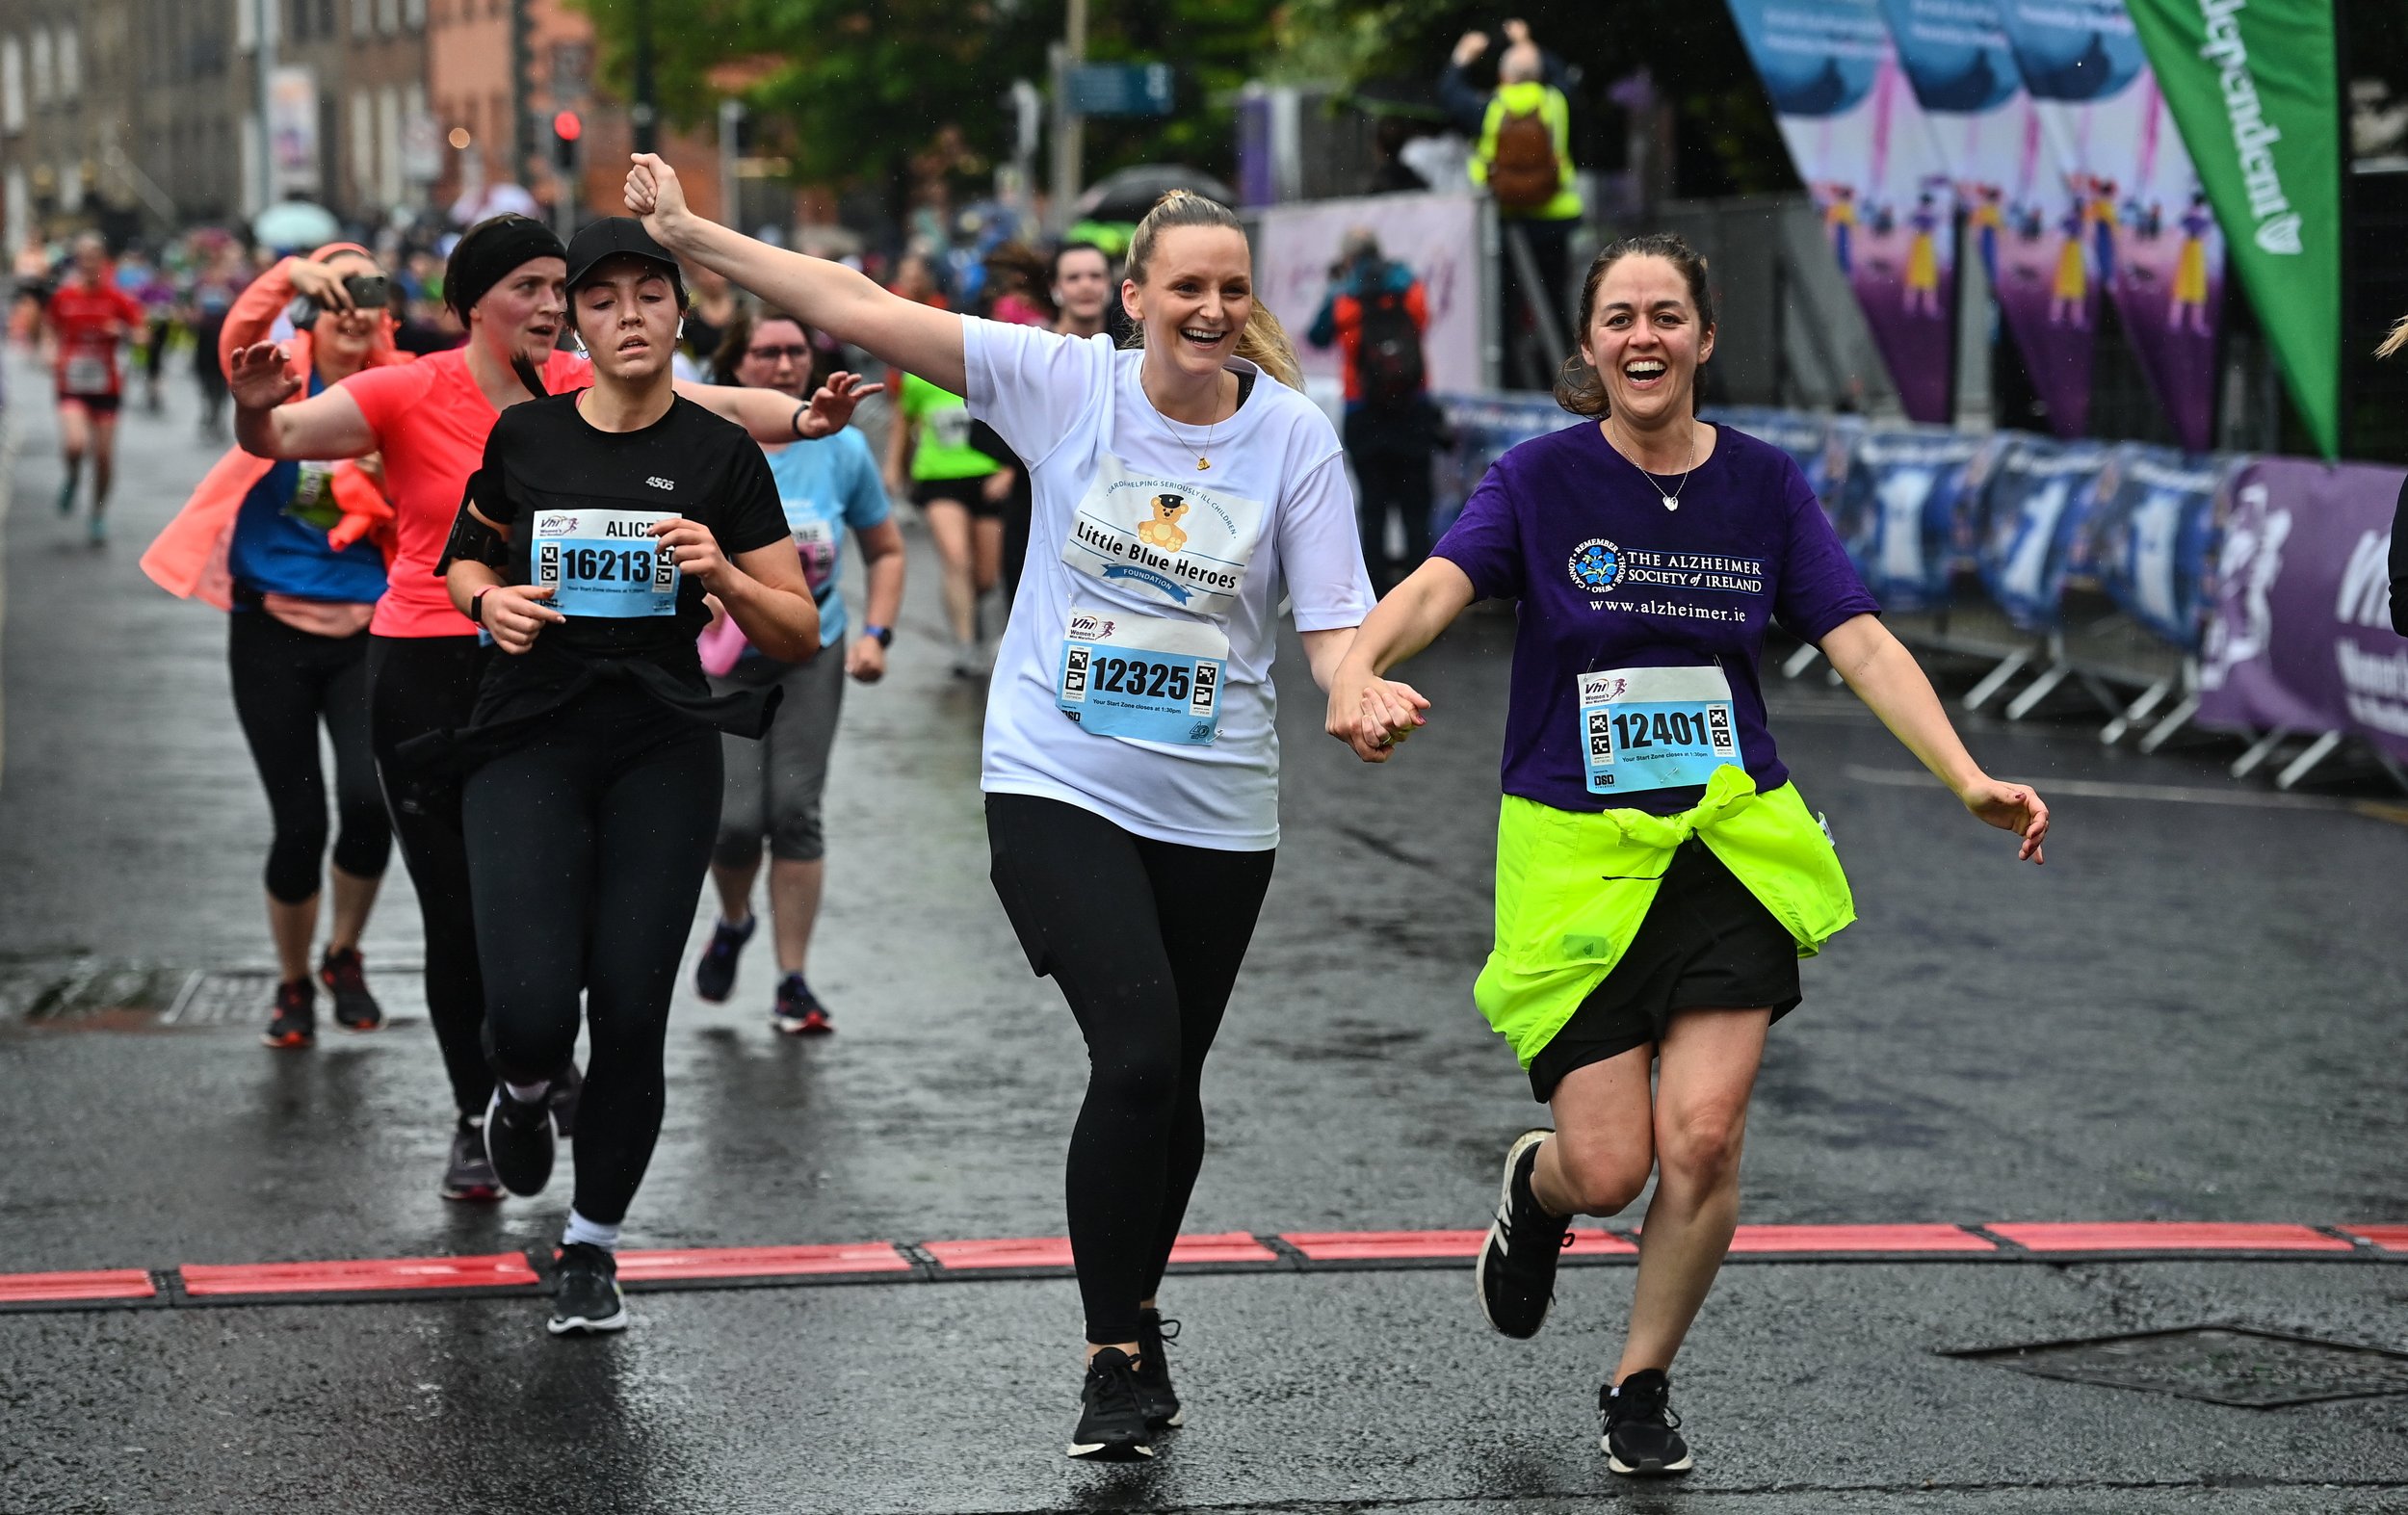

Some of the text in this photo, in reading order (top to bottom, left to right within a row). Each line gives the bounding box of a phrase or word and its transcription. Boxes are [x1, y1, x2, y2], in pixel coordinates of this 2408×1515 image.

[1160, 481, 1201, 497] SERIOUSLY
[1201, 494, 1211, 504] ILL
[1211, 502, 1238, 535] CHILDREN
[563, 549, 651, 583] 16213
[1076, 521, 1237, 589] Little Blue Heroes
[1568, 538, 1627, 593] REMEMBER THOSE WHO CANNOT
[1627, 551, 1762, 575] THE ALZHEIMER
[1123, 568, 1173, 590] FOUNDATION
[1628, 569, 1763, 592] SOCIETY of IRELAND
[1589, 600, 1746, 622] www.alzheimer.ie
[1070, 629, 1096, 638] Women's
[1071, 617, 1095, 630] Vhi
[1092, 657, 1191, 700] 12325
[1585, 683, 1607, 694] Vhi
[1161, 706, 1182, 715] 1:30pm
[1611, 712, 1709, 750] 12401
